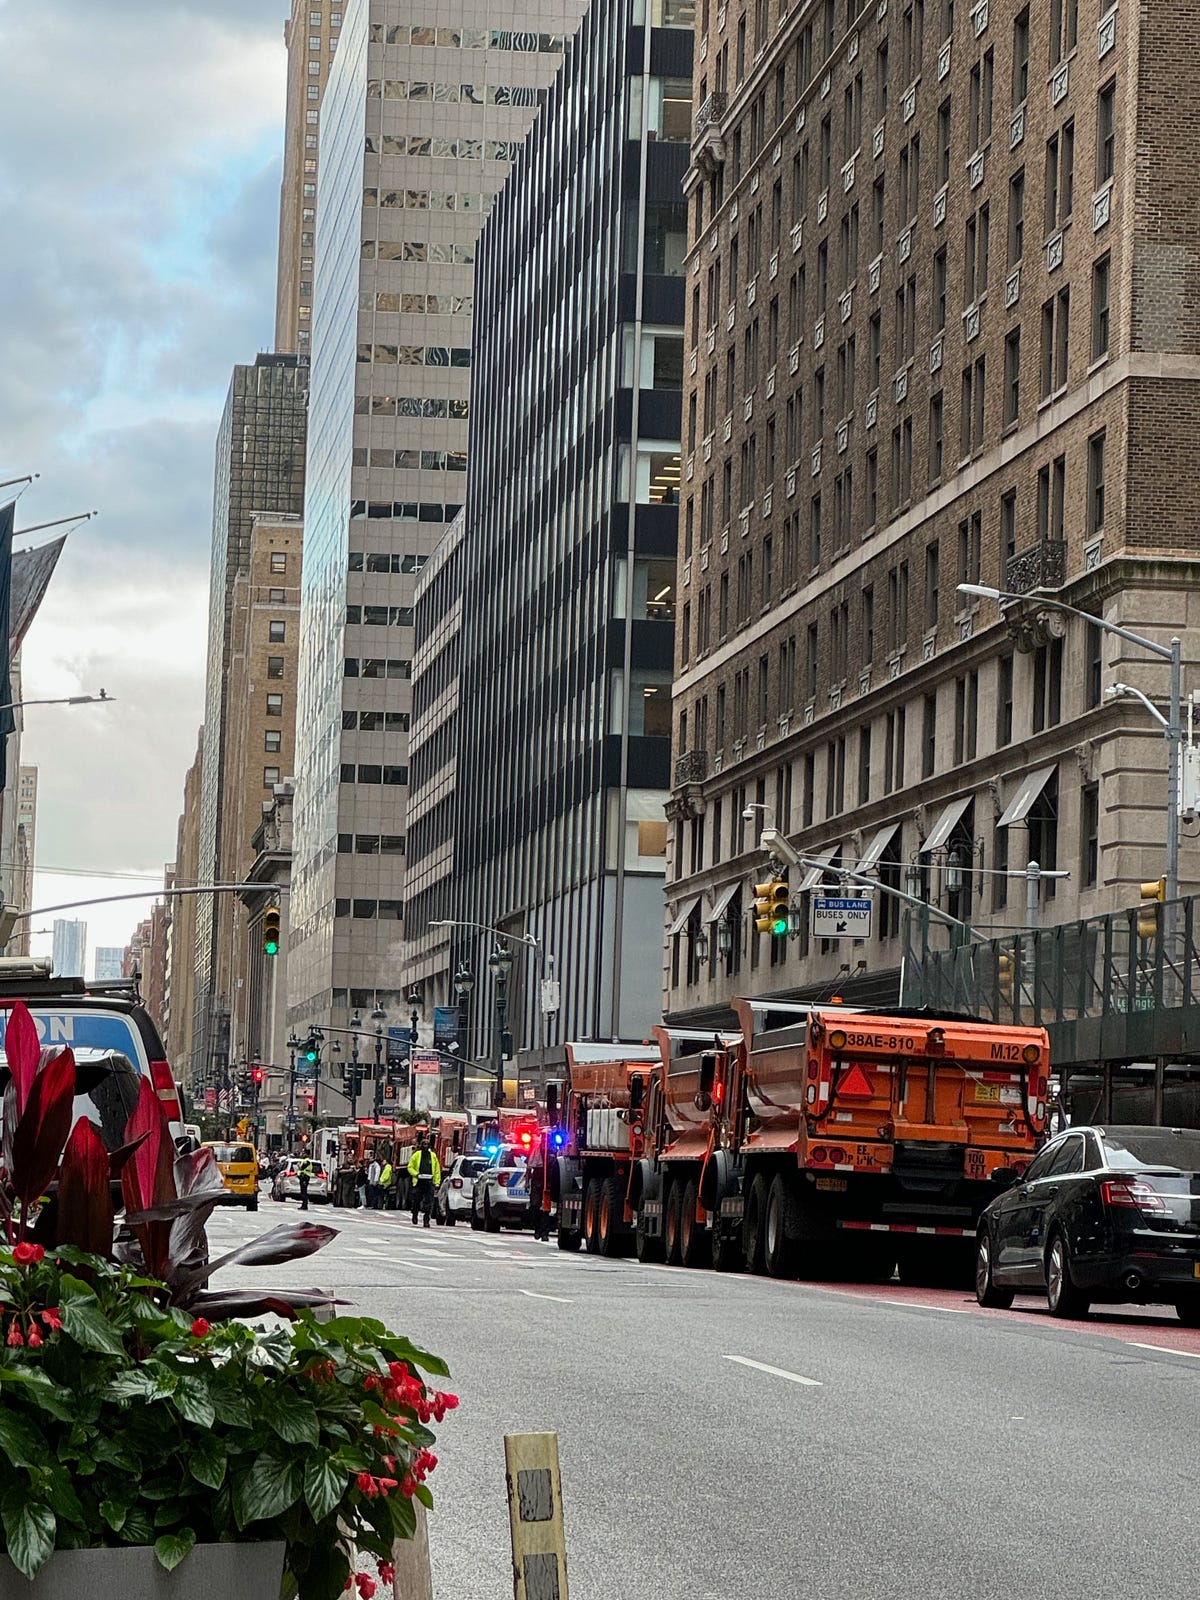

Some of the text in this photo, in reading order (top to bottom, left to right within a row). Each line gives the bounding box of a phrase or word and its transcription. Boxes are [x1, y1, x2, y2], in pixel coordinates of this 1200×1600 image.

[829, 901, 868, 909] BUS LANE
[816, 910, 868, 920] BUSES ONLY
[847, 1033, 915, 1050] 38AE-810
[968, 1153, 985, 1164] 100
